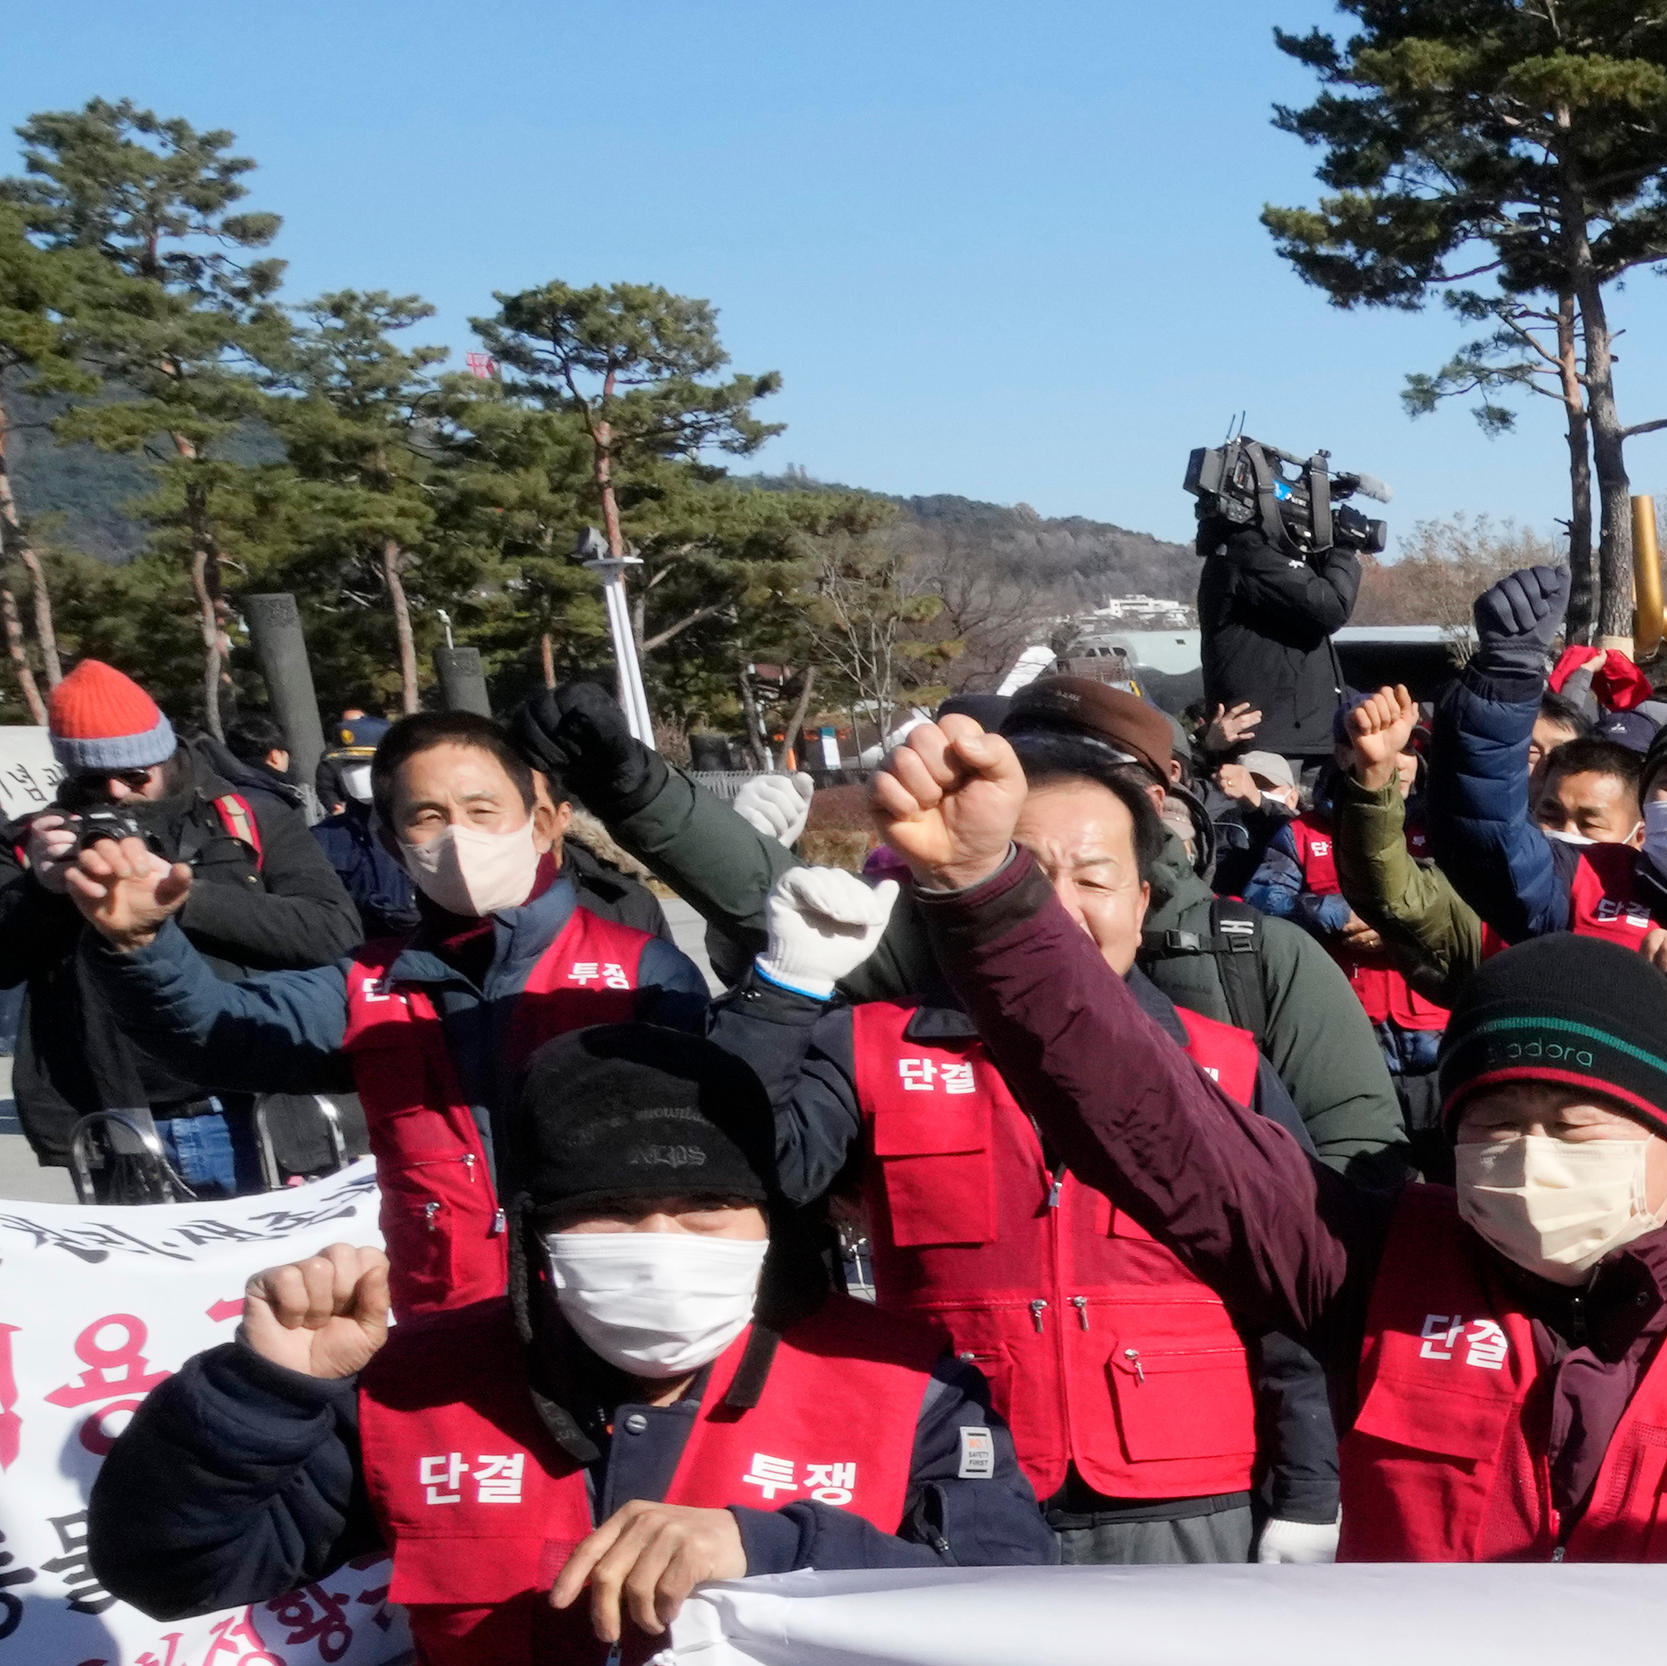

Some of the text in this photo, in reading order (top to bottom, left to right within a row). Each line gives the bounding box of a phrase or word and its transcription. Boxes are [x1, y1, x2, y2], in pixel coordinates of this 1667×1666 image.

[1598, 898, 1651, 928] 단결
[899, 1058, 977, 1095] 단결
[1420, 1314, 1509, 1370] 단결
[420, 1452, 524, 1505] 단결
[743, 1452, 857, 1506] 투쟁
